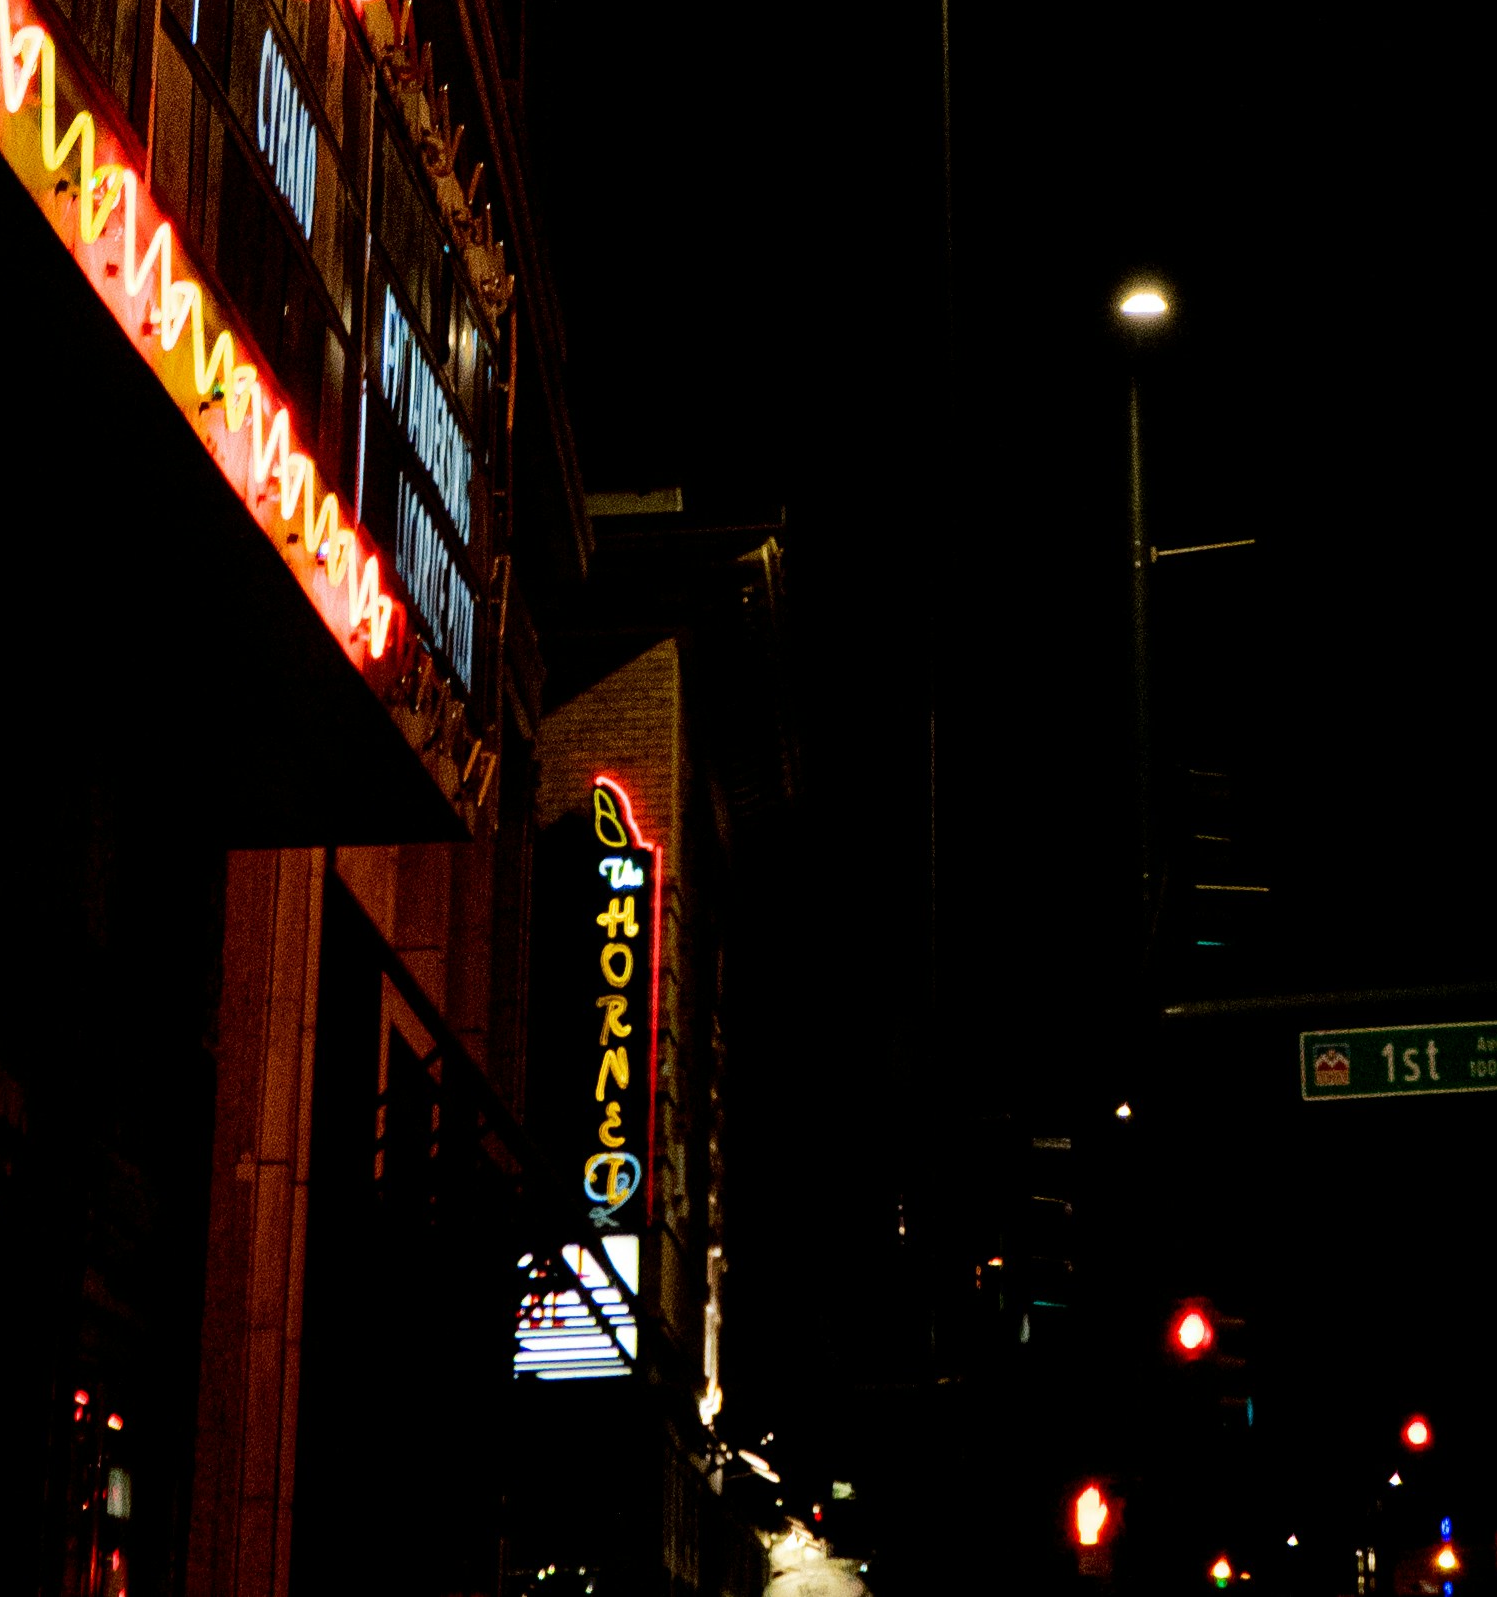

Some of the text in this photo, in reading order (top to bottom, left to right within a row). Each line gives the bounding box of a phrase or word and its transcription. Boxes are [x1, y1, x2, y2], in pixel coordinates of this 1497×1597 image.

[256, 27, 316, 240] CYRANO
[584, 894, 639, 1206] HORNET
[1380, 1038, 1441, 1084] 1st
